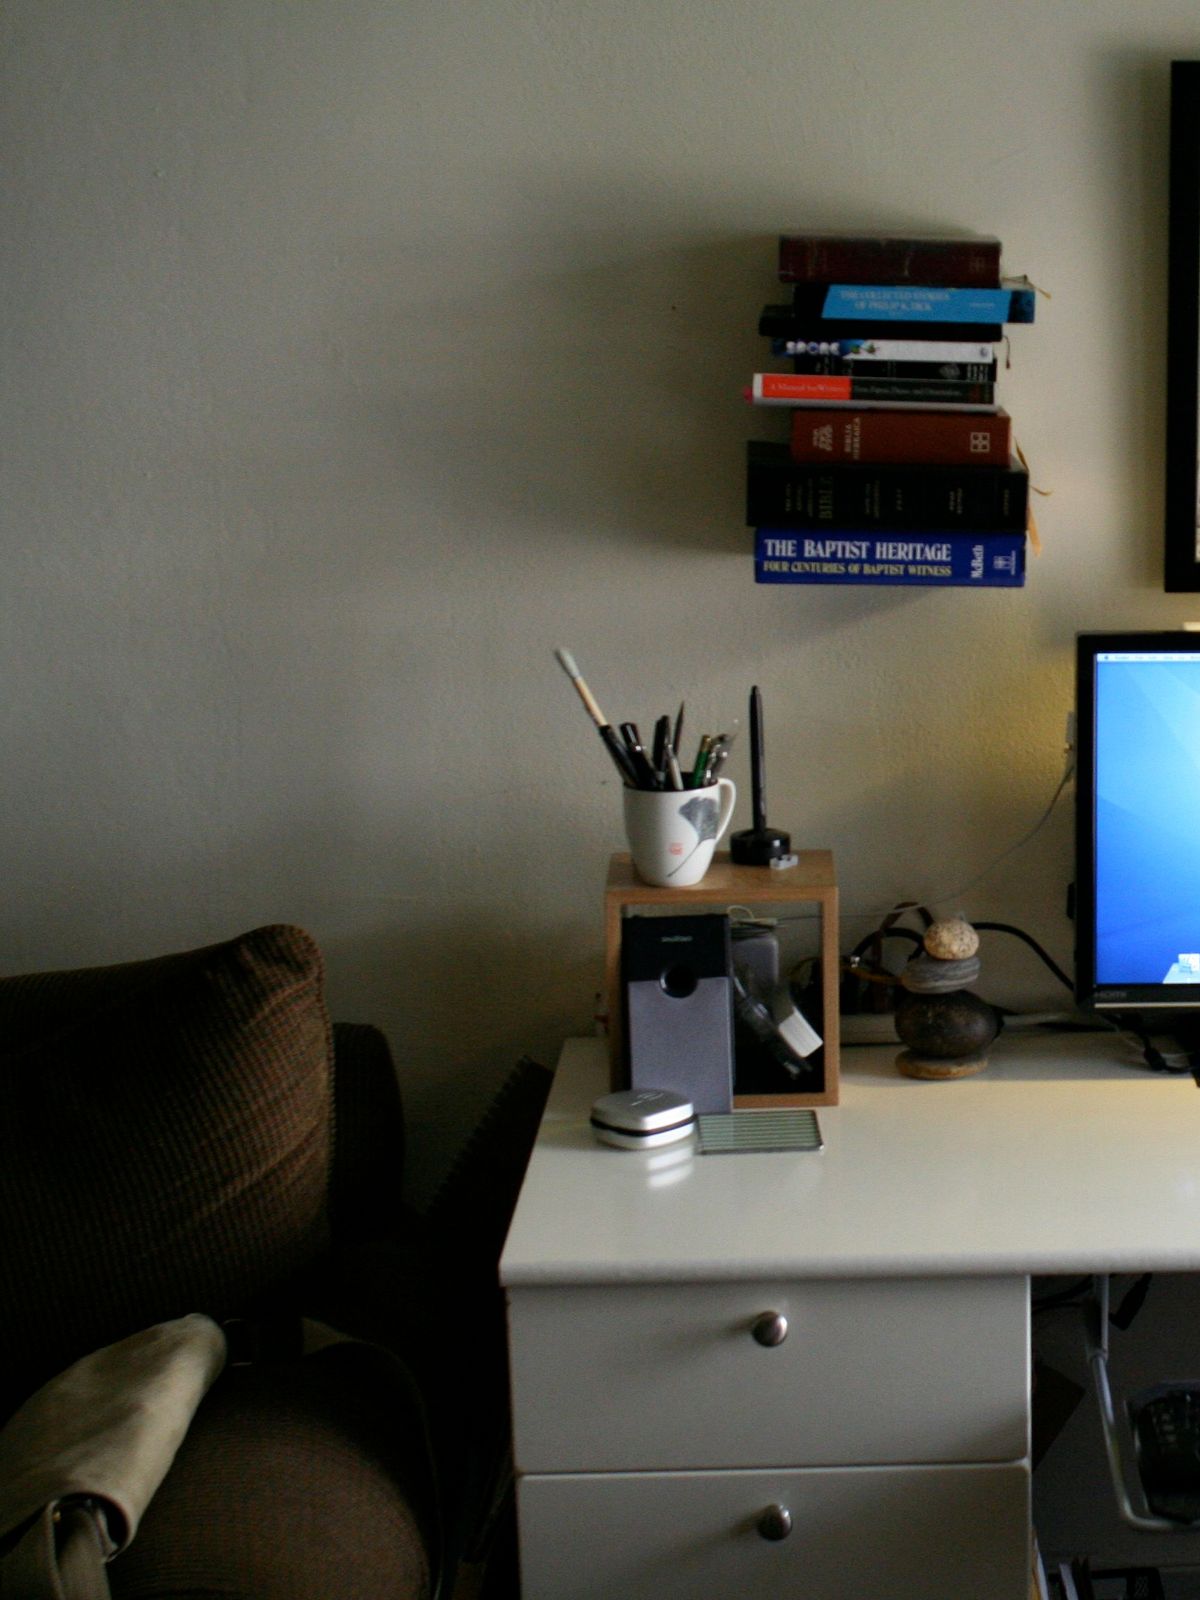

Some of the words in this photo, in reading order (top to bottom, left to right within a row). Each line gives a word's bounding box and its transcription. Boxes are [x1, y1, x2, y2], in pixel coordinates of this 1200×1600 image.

[764, 539, 797, 557] THE
[803, 540, 869, 560] BAPTIST
[874, 542, 952, 562] HERITAGE
[970, 544, 984, 579] McBeth
[763, 560, 789, 573] FOUR
[790, 561, 846, 574] CENTURIES
[847, 562, 861, 575] OF
[862, 562, 905, 576] BAPTIST
[906, 564, 952, 577] WITNESS
